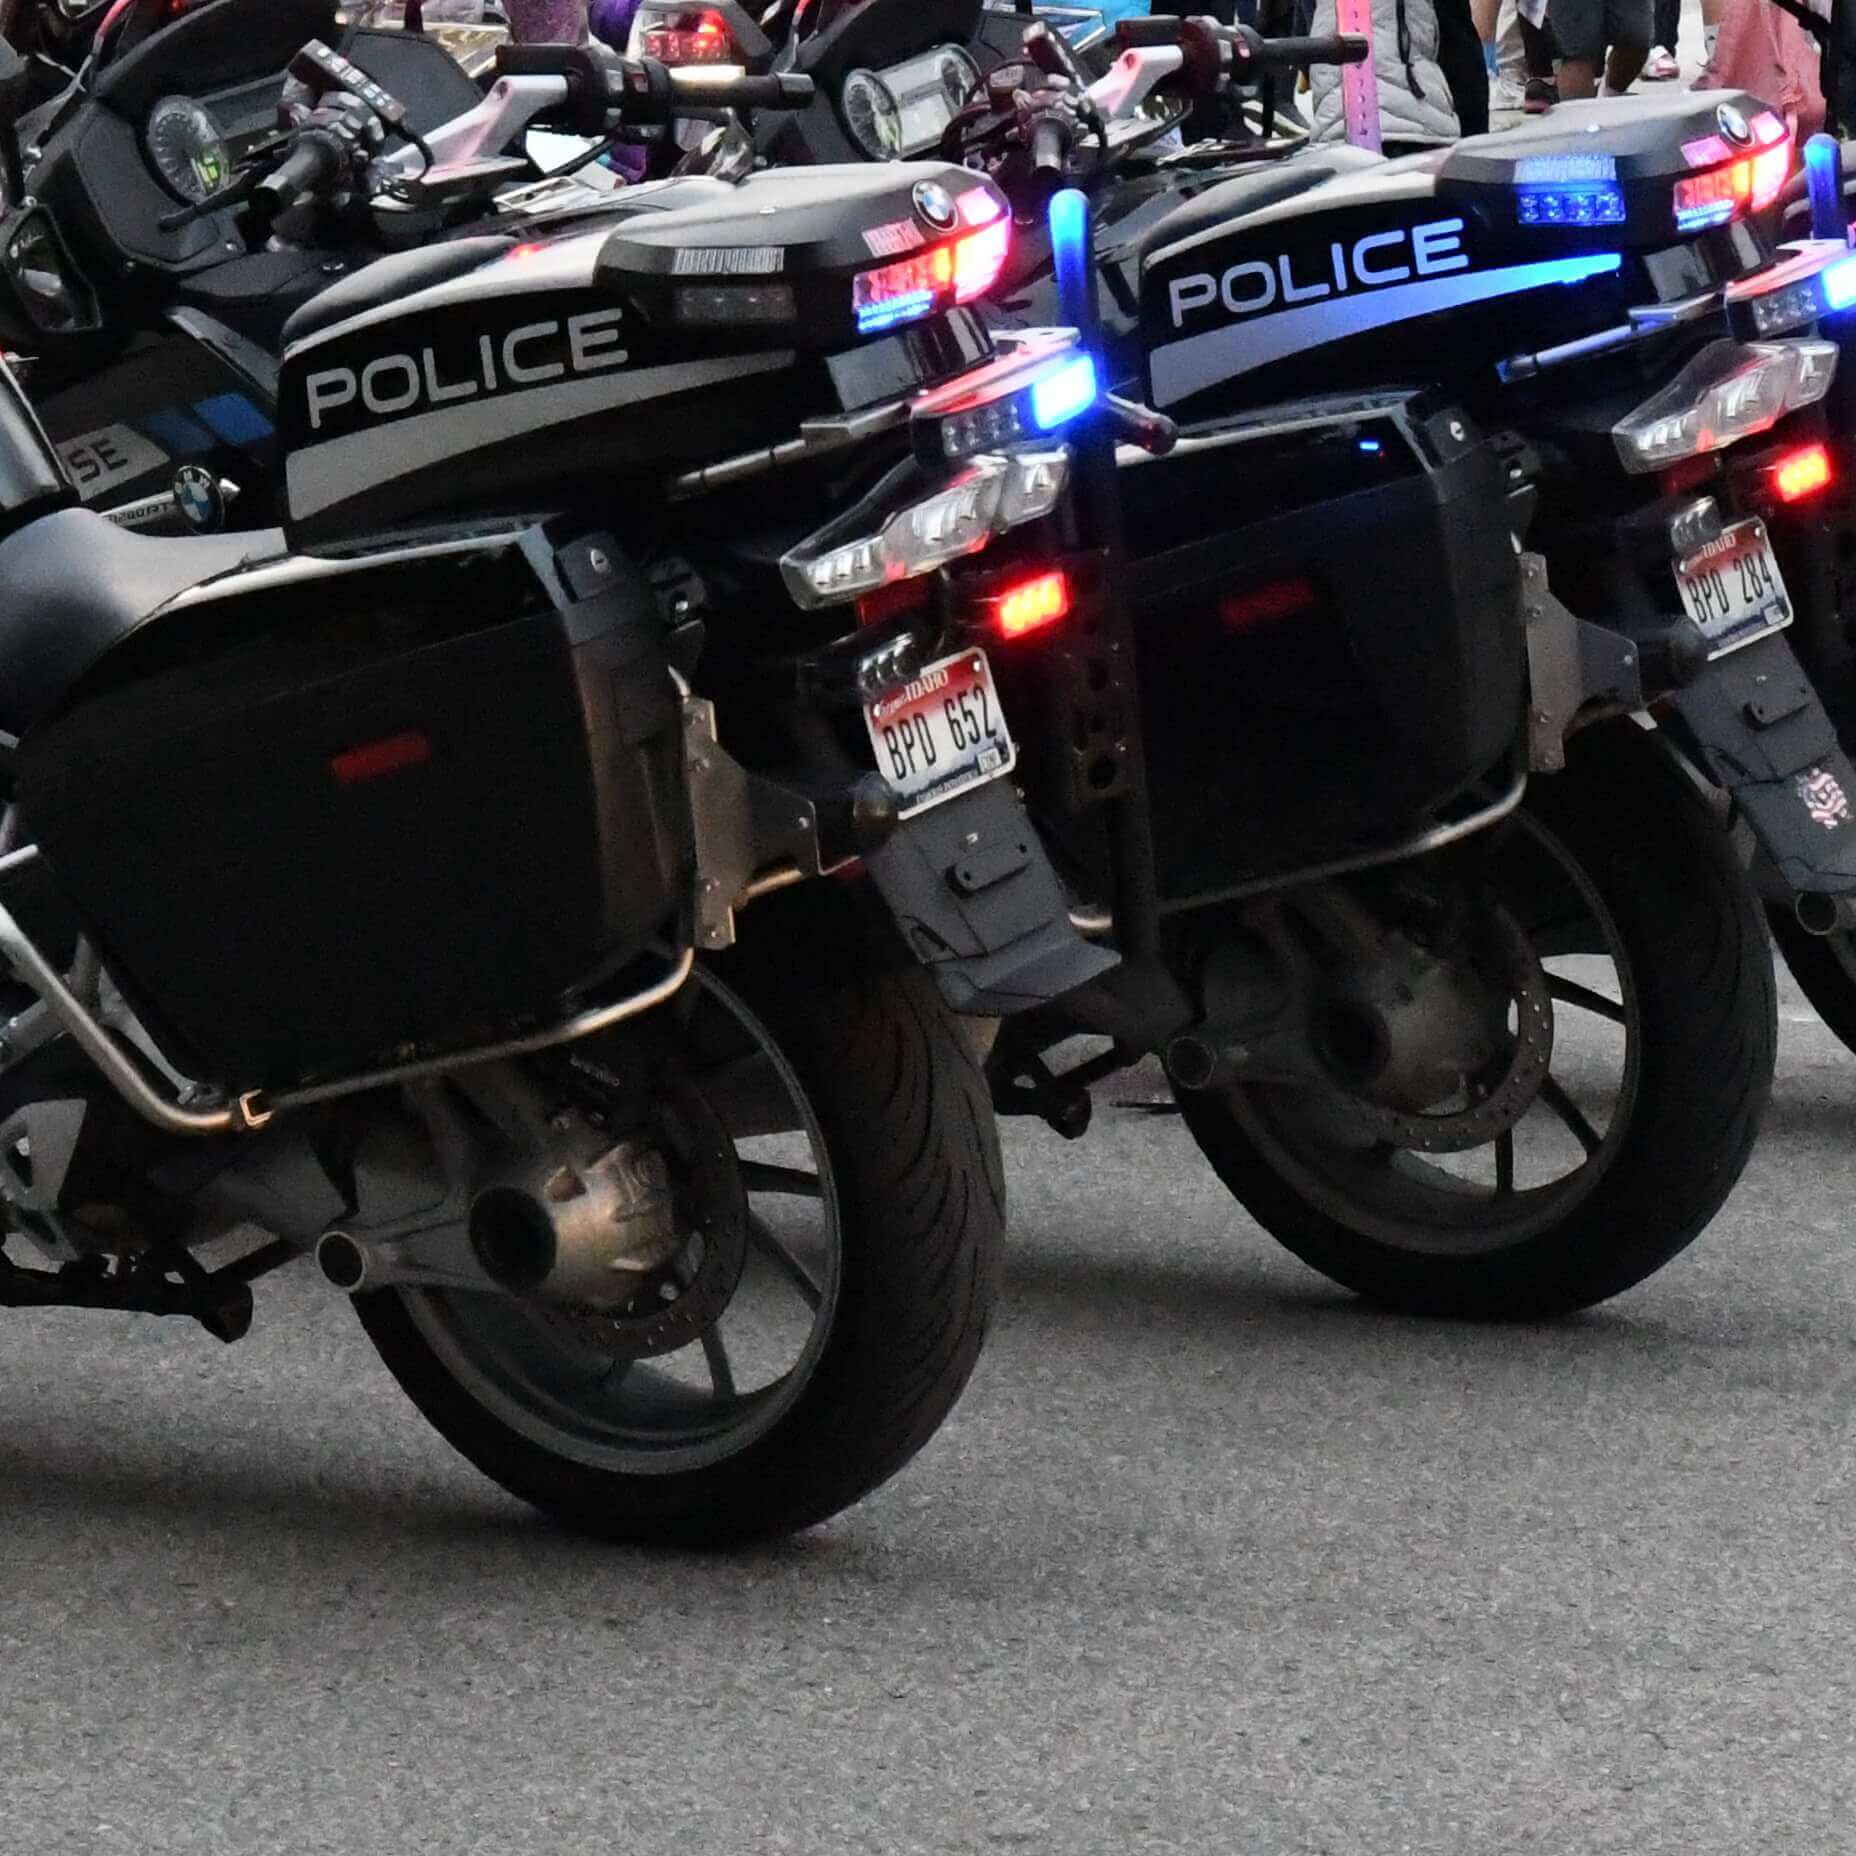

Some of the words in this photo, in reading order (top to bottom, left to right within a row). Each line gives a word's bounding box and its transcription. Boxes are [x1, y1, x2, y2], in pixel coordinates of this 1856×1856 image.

[1168, 217, 1469, 328] POLICE
[305, 307, 629, 430] POLICE
[1686, 568, 1731, 625] BPD
[1734, 550, 1773, 605] 284
[883, 711, 937, 781] BPD
[944, 685, 997, 751] 652
[904, 669, 950, 702] IDAHO
